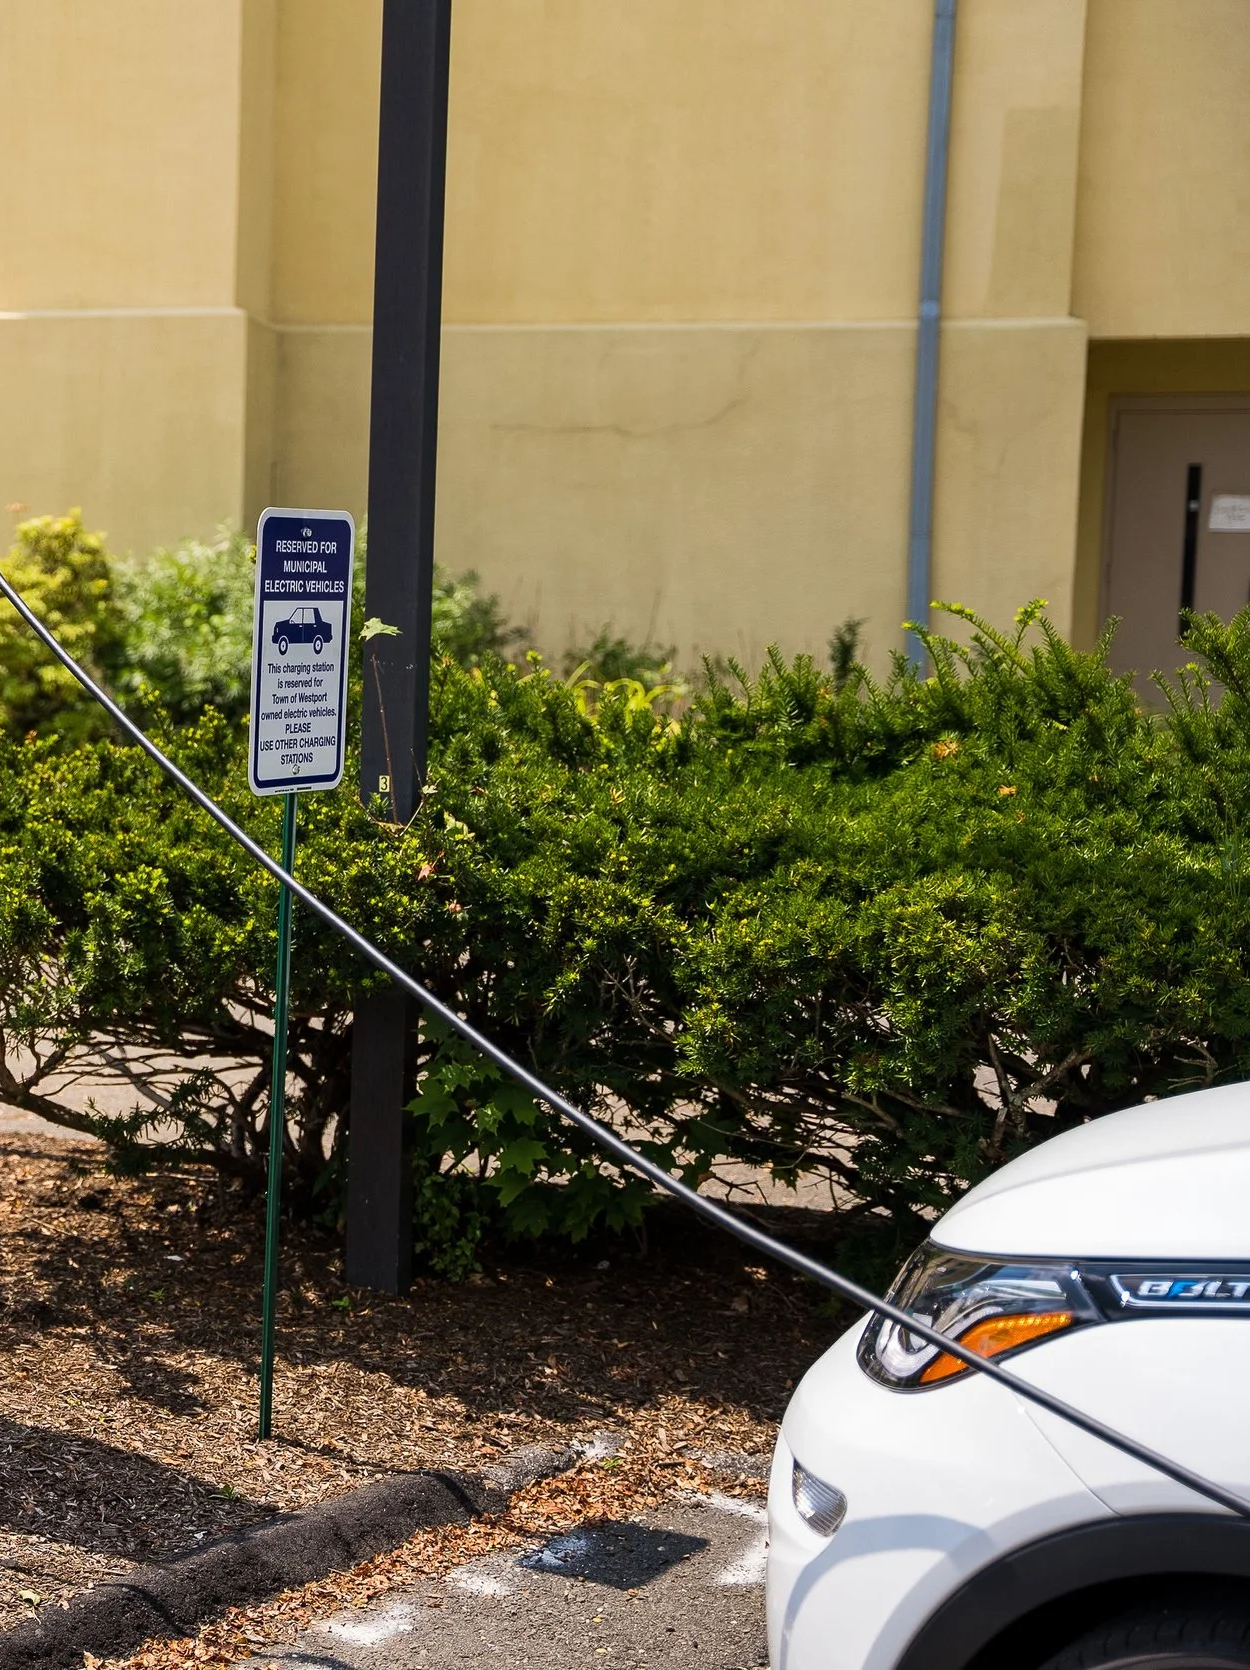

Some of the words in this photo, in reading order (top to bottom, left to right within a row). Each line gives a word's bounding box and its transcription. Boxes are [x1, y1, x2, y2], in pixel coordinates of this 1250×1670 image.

[276, 540, 318, 553] RESERVED
[320, 542, 337, 554] FOR
[284, 560, 327, 573] MUNICIPAL
[265, 580, 303, 593] ELECTRIC
[306, 581, 344, 593] VEHICLES
[268, 663, 281, 674] This
[283, 662, 311, 675] charging
[312, 662, 334, 672] station
[278, 679, 283, 689] is
[285, 677, 312, 688] reserved
[314, 677, 323, 687] for
[272, 694, 289, 704] Town
[291, 693, 298, 703] of
[299, 692, 327, 704] Westport
[261, 709, 282, 720] owned
[284, 708, 308, 719] electric
[309, 707, 336, 717] vehicles.
[285, 723, 311, 734] PLEASE
[260, 740, 273, 751] USE
[275, 739, 298, 750] OTHER
[299, 736, 335, 748] CHARGING
[281, 752, 313, 765] STATIONS
